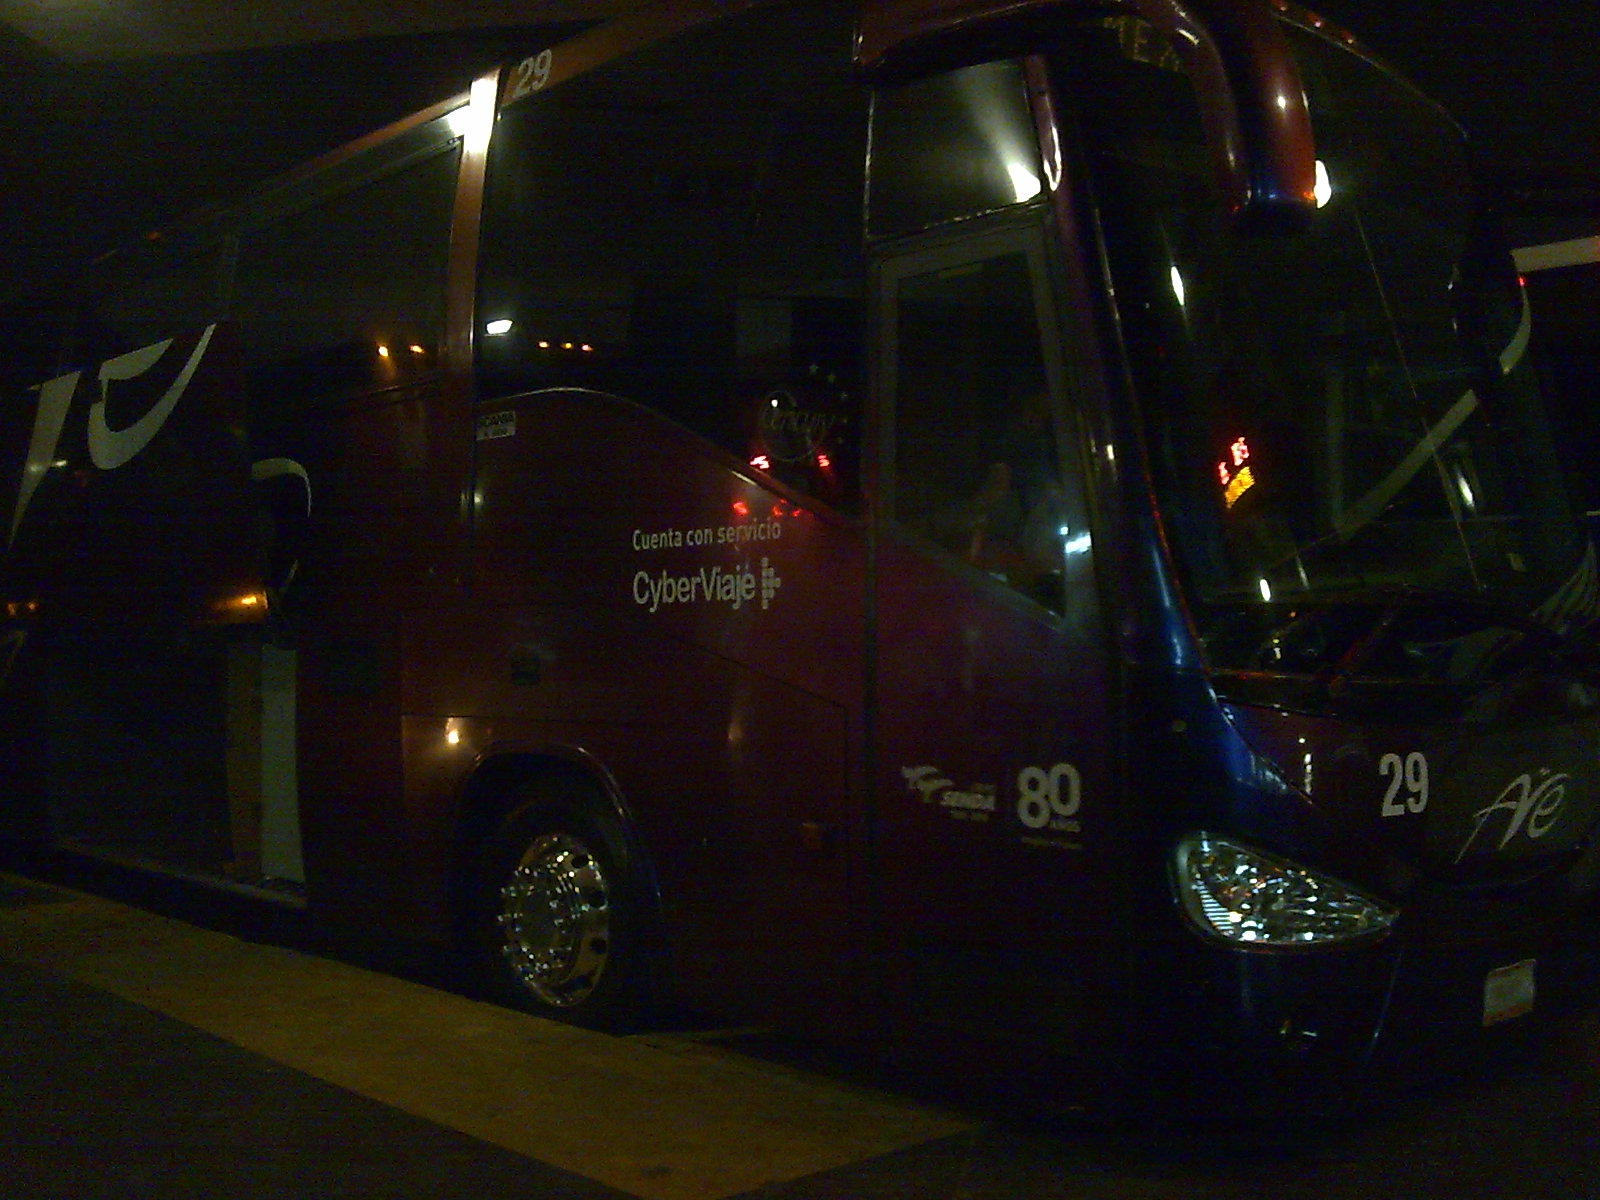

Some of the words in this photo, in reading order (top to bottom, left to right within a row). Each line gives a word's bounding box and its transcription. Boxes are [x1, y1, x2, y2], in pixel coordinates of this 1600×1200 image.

[513, 49, 552, 98] 29
[632, 529, 682, 550] Cuenta
[687, 527, 713, 546] con
[717, 517, 781, 543] servicio
[1017, 763, 1081, 828] 80
[1379, 751, 1429, 817] 29
